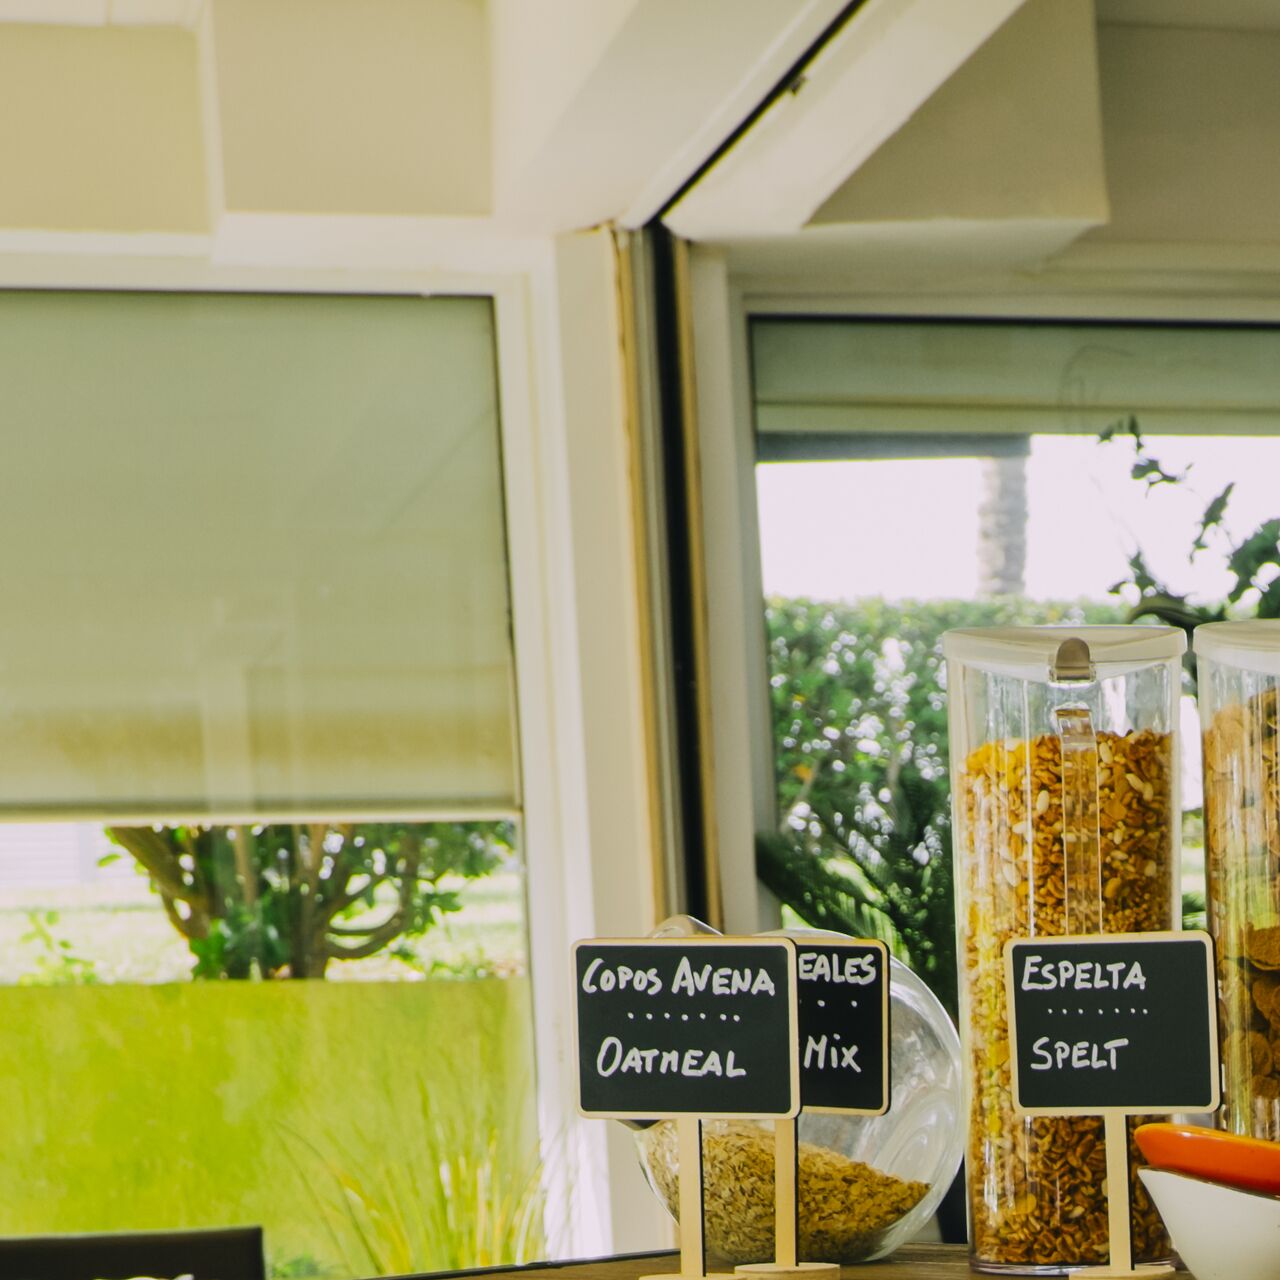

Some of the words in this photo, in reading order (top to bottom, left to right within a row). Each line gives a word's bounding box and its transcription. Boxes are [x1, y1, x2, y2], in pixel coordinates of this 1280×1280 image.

[671, 956, 776, 996] AVENA
[798, 952, 877, 985] EALES
[1021, 955, 1147, 991] ESPELTA
[597, 1036, 746, 1078] OATMEAL
[1030, 1036, 1129, 1070] SPELT
